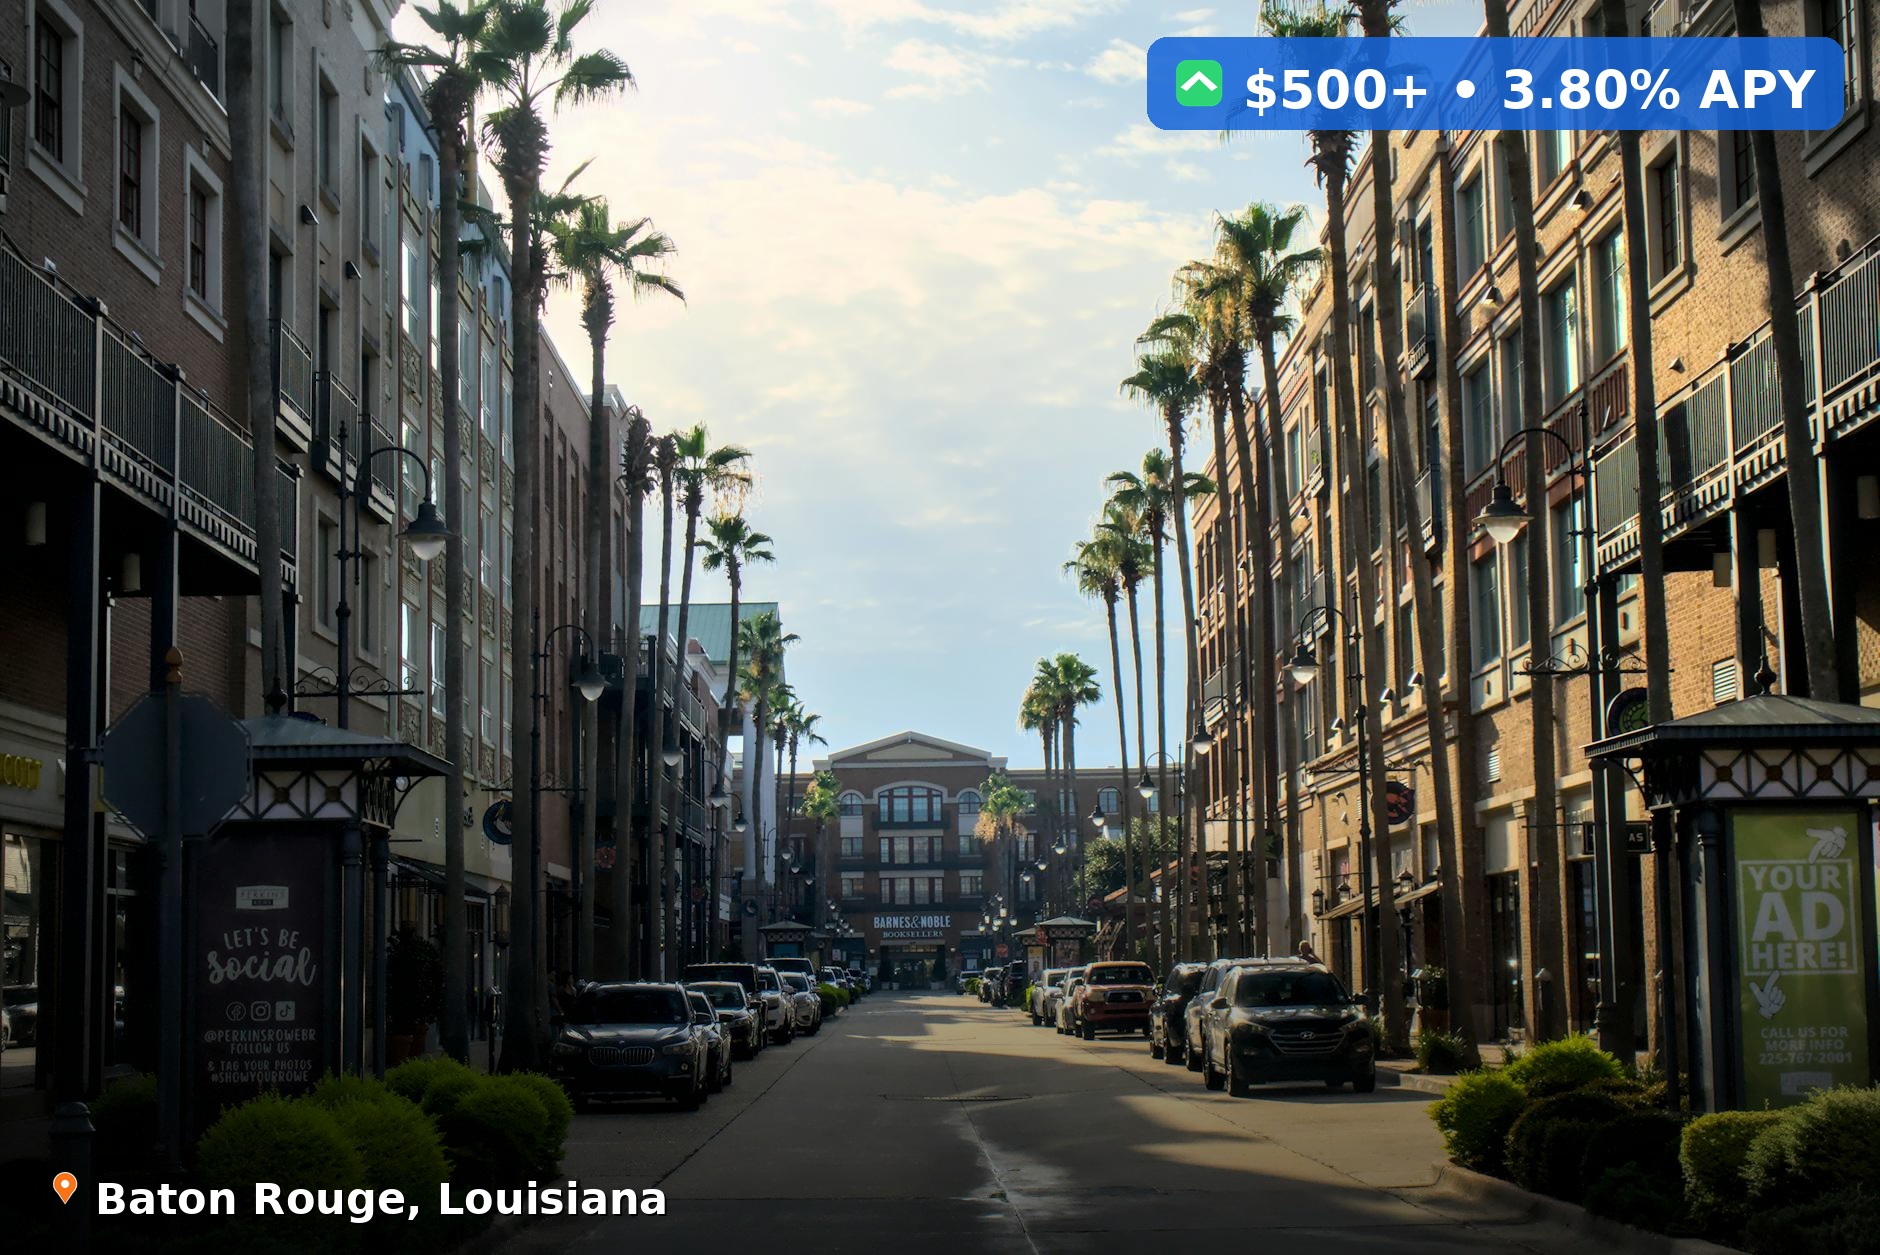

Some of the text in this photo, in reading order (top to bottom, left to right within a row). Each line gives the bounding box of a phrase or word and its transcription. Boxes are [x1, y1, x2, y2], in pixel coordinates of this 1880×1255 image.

[1748, 864, 1842, 892] YOUR
[1752, 891, 1845, 942] AD
[223, 927, 301, 950] LET'S BE
[882, 930, 943, 938] BOOKSELLERS
[1752, 941, 1848, 970] HERE!
[204, 1029, 317, 1043] @PERKINSROWEBR
[1760, 1026, 1848, 1039] CALL US FOR
[230, 1043, 290, 1055] FOLLOW US
[1766, 1039, 1845, 1051] MORE INFO
[1759, 1052, 1852, 1064] 225-767-2001
[220, 1061, 240, 1072] TAG
[243, 1060, 271, 1071] YOUR
[274, 1059, 313, 1071] PHOTOS
